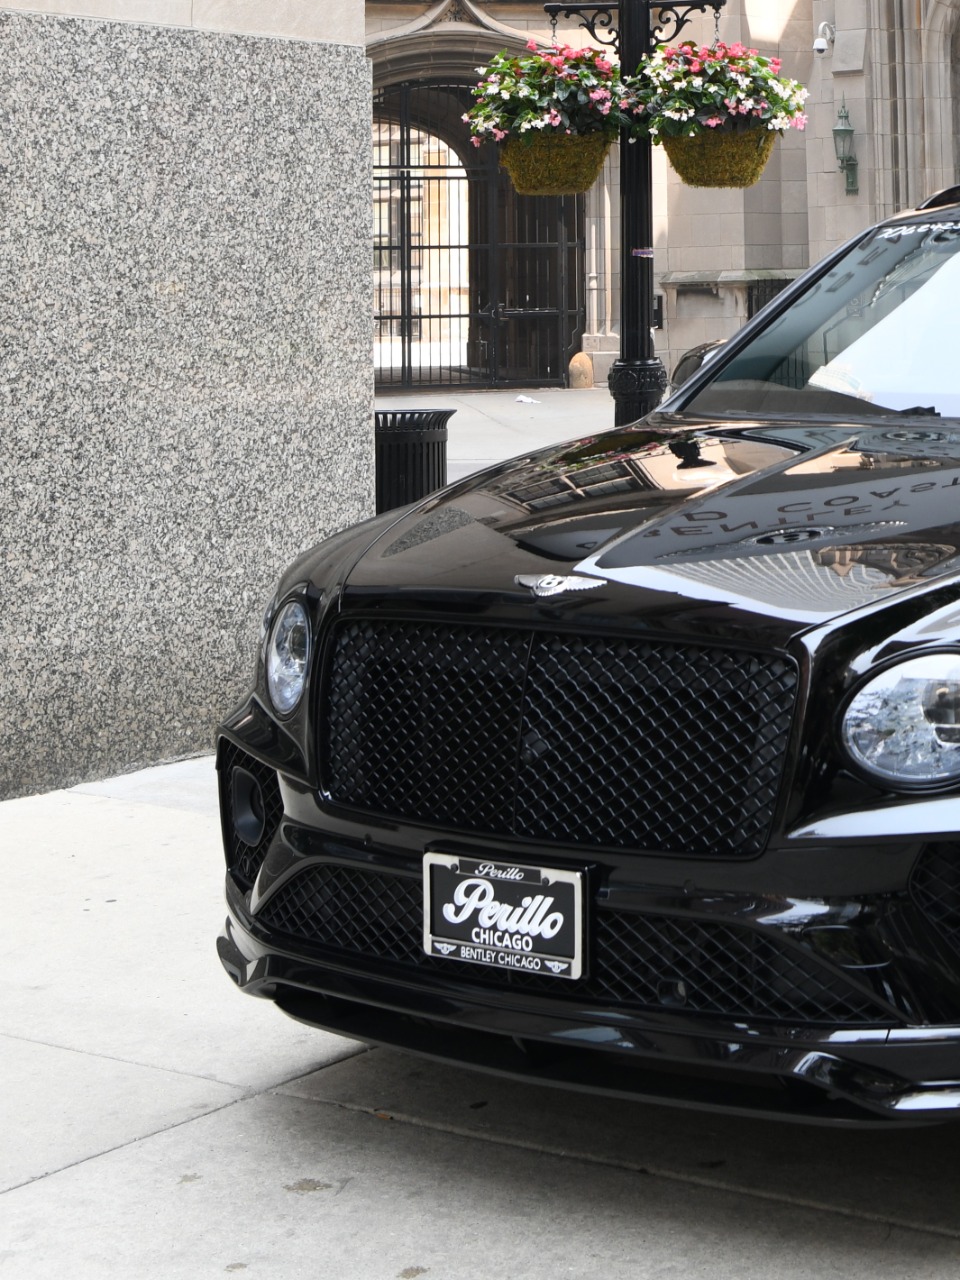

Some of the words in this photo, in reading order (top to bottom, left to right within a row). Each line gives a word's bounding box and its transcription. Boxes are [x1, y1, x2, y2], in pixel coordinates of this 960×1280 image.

[474, 862, 525, 881] Perillo
[442, 878, 564, 939] Perillo
[471, 927, 533, 952] CHICAGO
[460, 946, 496, 963] BENTLEY
[498, 952, 541, 970] CHICAGO
